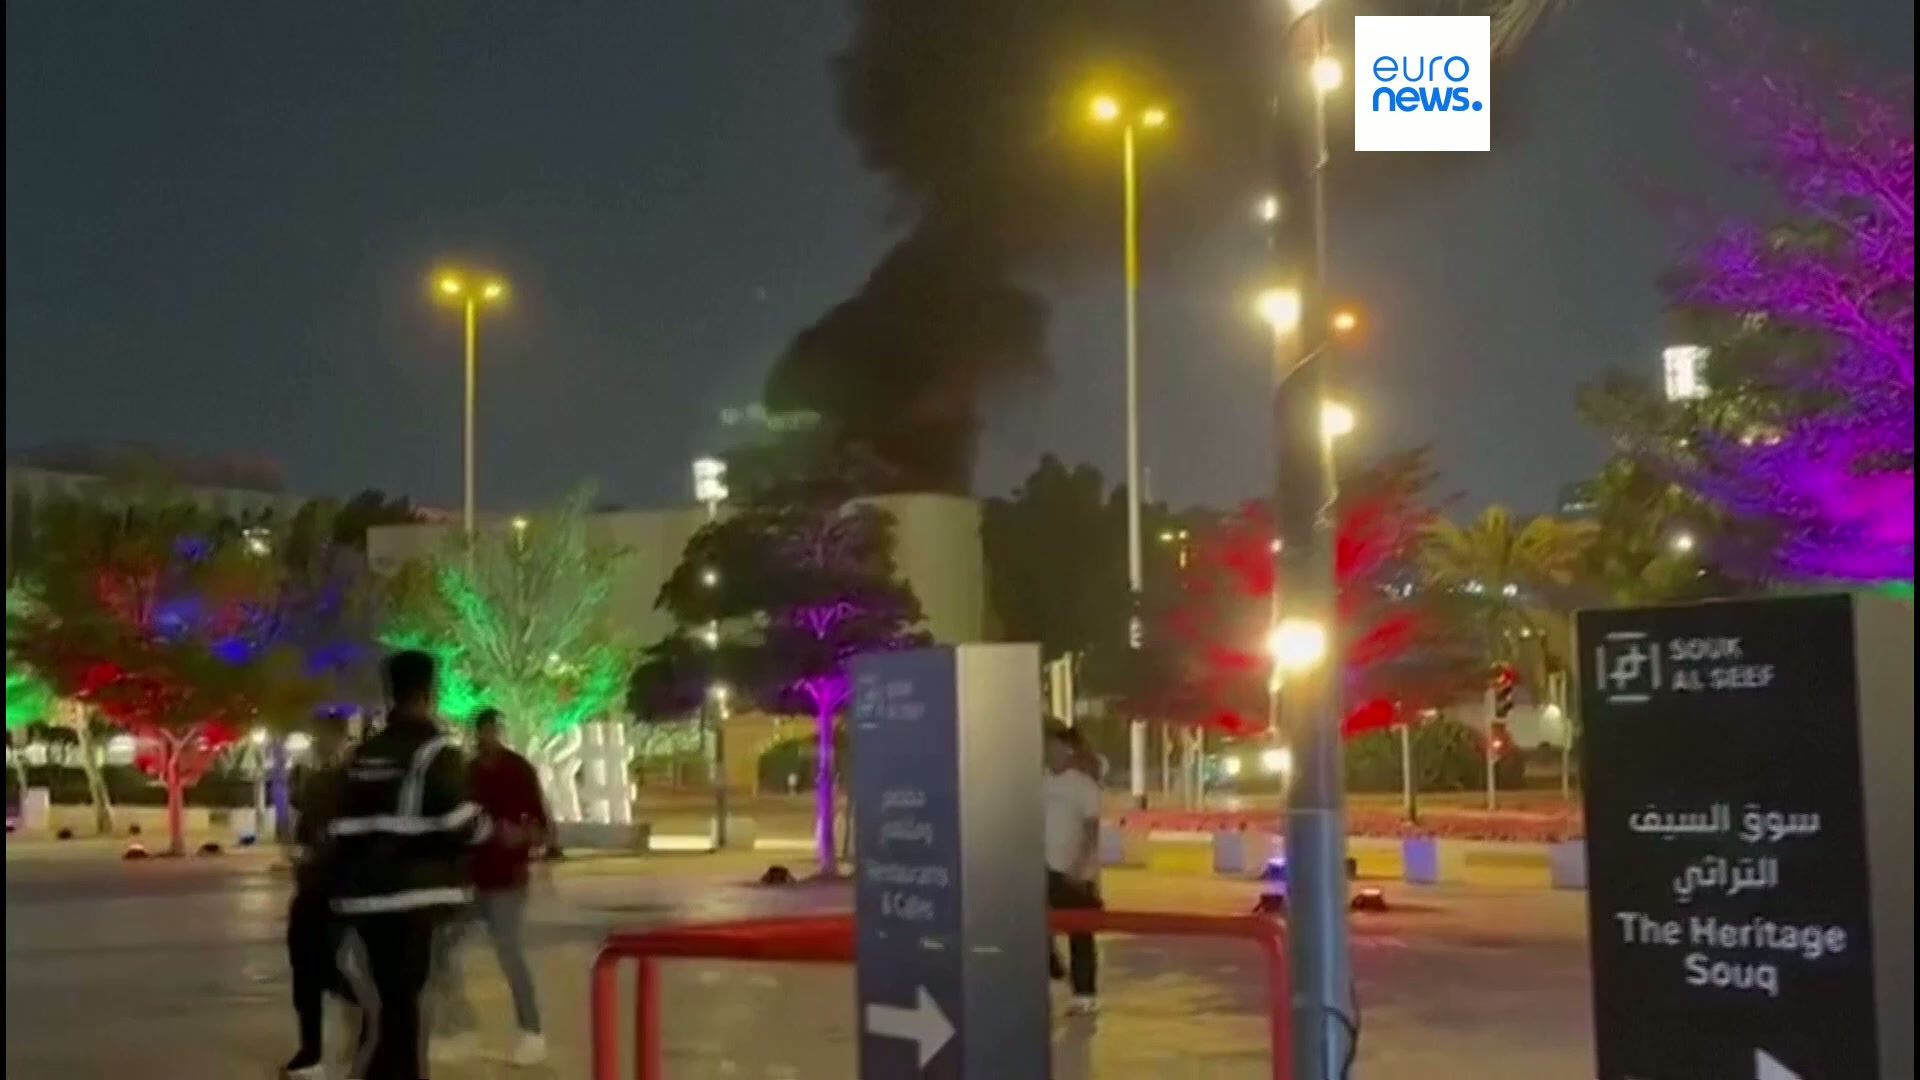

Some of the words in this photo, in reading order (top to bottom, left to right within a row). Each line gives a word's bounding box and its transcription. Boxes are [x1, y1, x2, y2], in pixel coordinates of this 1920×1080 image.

[1668, 637, 1743, 661] SOUK
[1672, 669, 1704, 691] AL
[1628, 802, 1730, 840] السيف
[1739, 803, 1821, 843] سوق
[1672, 854, 1779, 903] التراثي
[1614, 911, 1682, 946] The
[1688, 916, 1848, 960] Heritage
[1683, 952, 1779, 997] Souq
